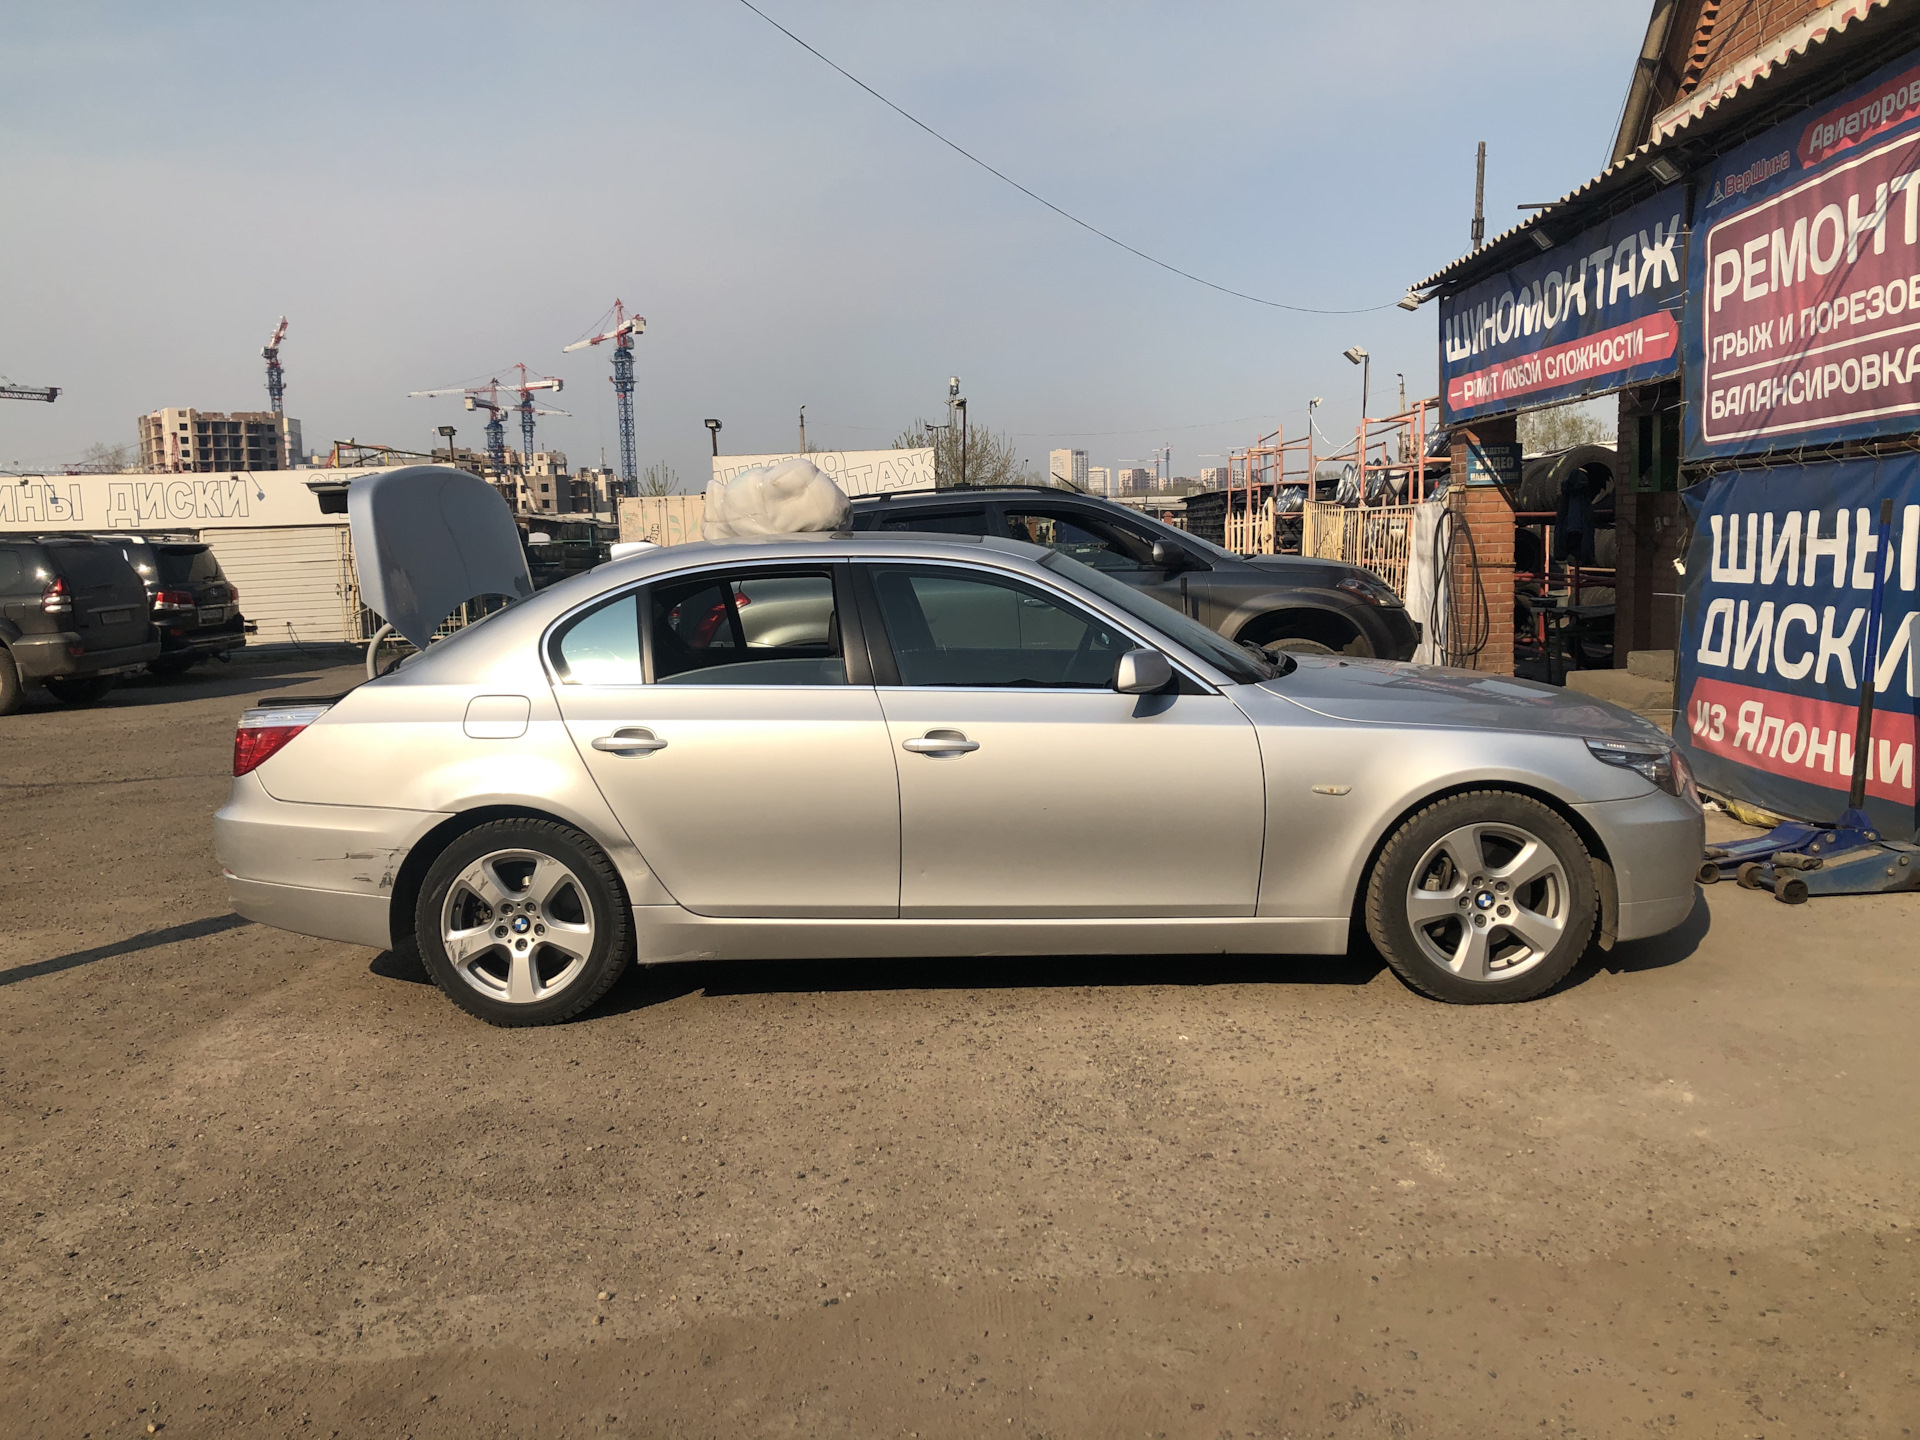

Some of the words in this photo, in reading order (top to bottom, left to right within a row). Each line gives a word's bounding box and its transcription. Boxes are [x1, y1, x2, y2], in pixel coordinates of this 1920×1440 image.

[1809, 80, 1920, 154] Авиаторов
[1713, 169, 1920, 312] РЕМОНТ
[1446, 214, 1680, 363] ШИНОМОНТАЖ
[1501, 354, 1542, 391] ЛЮБОЙ
[1545, 328, 1643, 379] СЛОЖНОСТИ
[1713, 320, 1774, 363] ГРЫЖ
[1779, 313, 1793, 345] И
[107, 480, 250, 527] ДИСКИ
[1710, 504, 1920, 591] ШИНЫ
[1693, 700, 1727, 741] из
[1733, 700, 1913, 788] Японии
